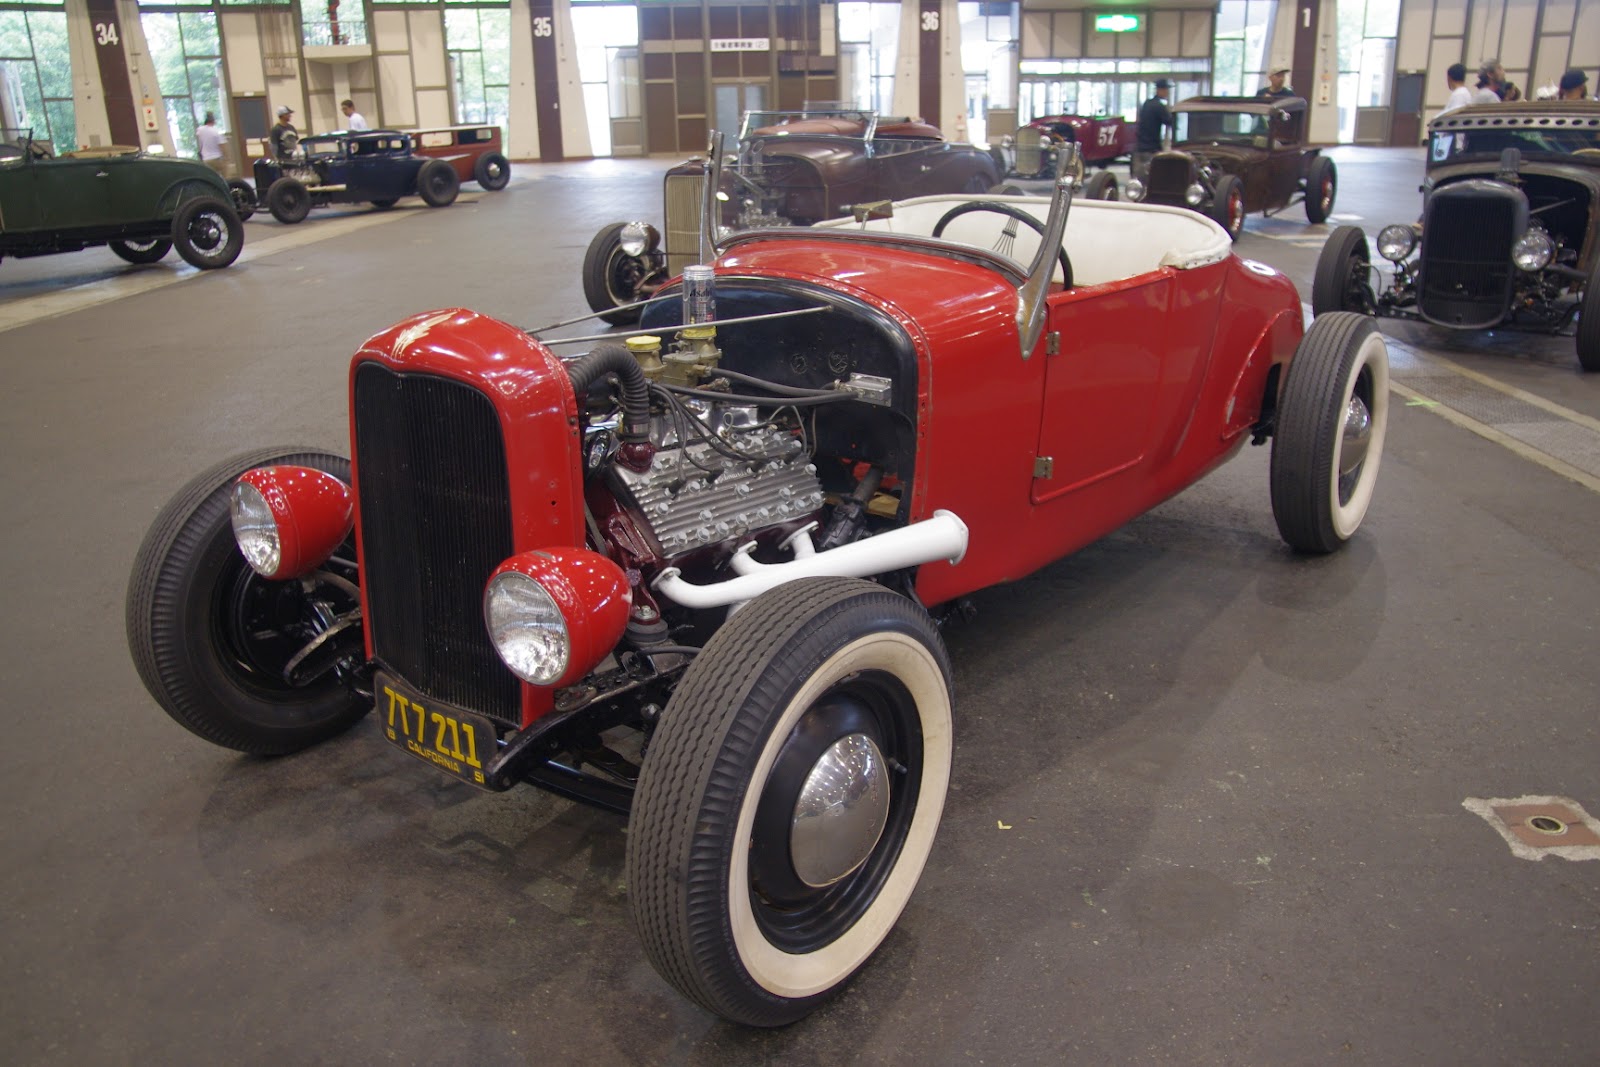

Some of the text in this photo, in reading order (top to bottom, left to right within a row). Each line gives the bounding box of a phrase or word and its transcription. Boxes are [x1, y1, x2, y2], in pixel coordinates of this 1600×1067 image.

[533, 16, 552, 37] 35
[921, 10, 940, 31] 36
[1303, 7, 1311, 28] 1
[95, 22, 119, 46] 34
[431, 712, 482, 769] 211
[407, 739, 460, 774] CALIFORNIA
